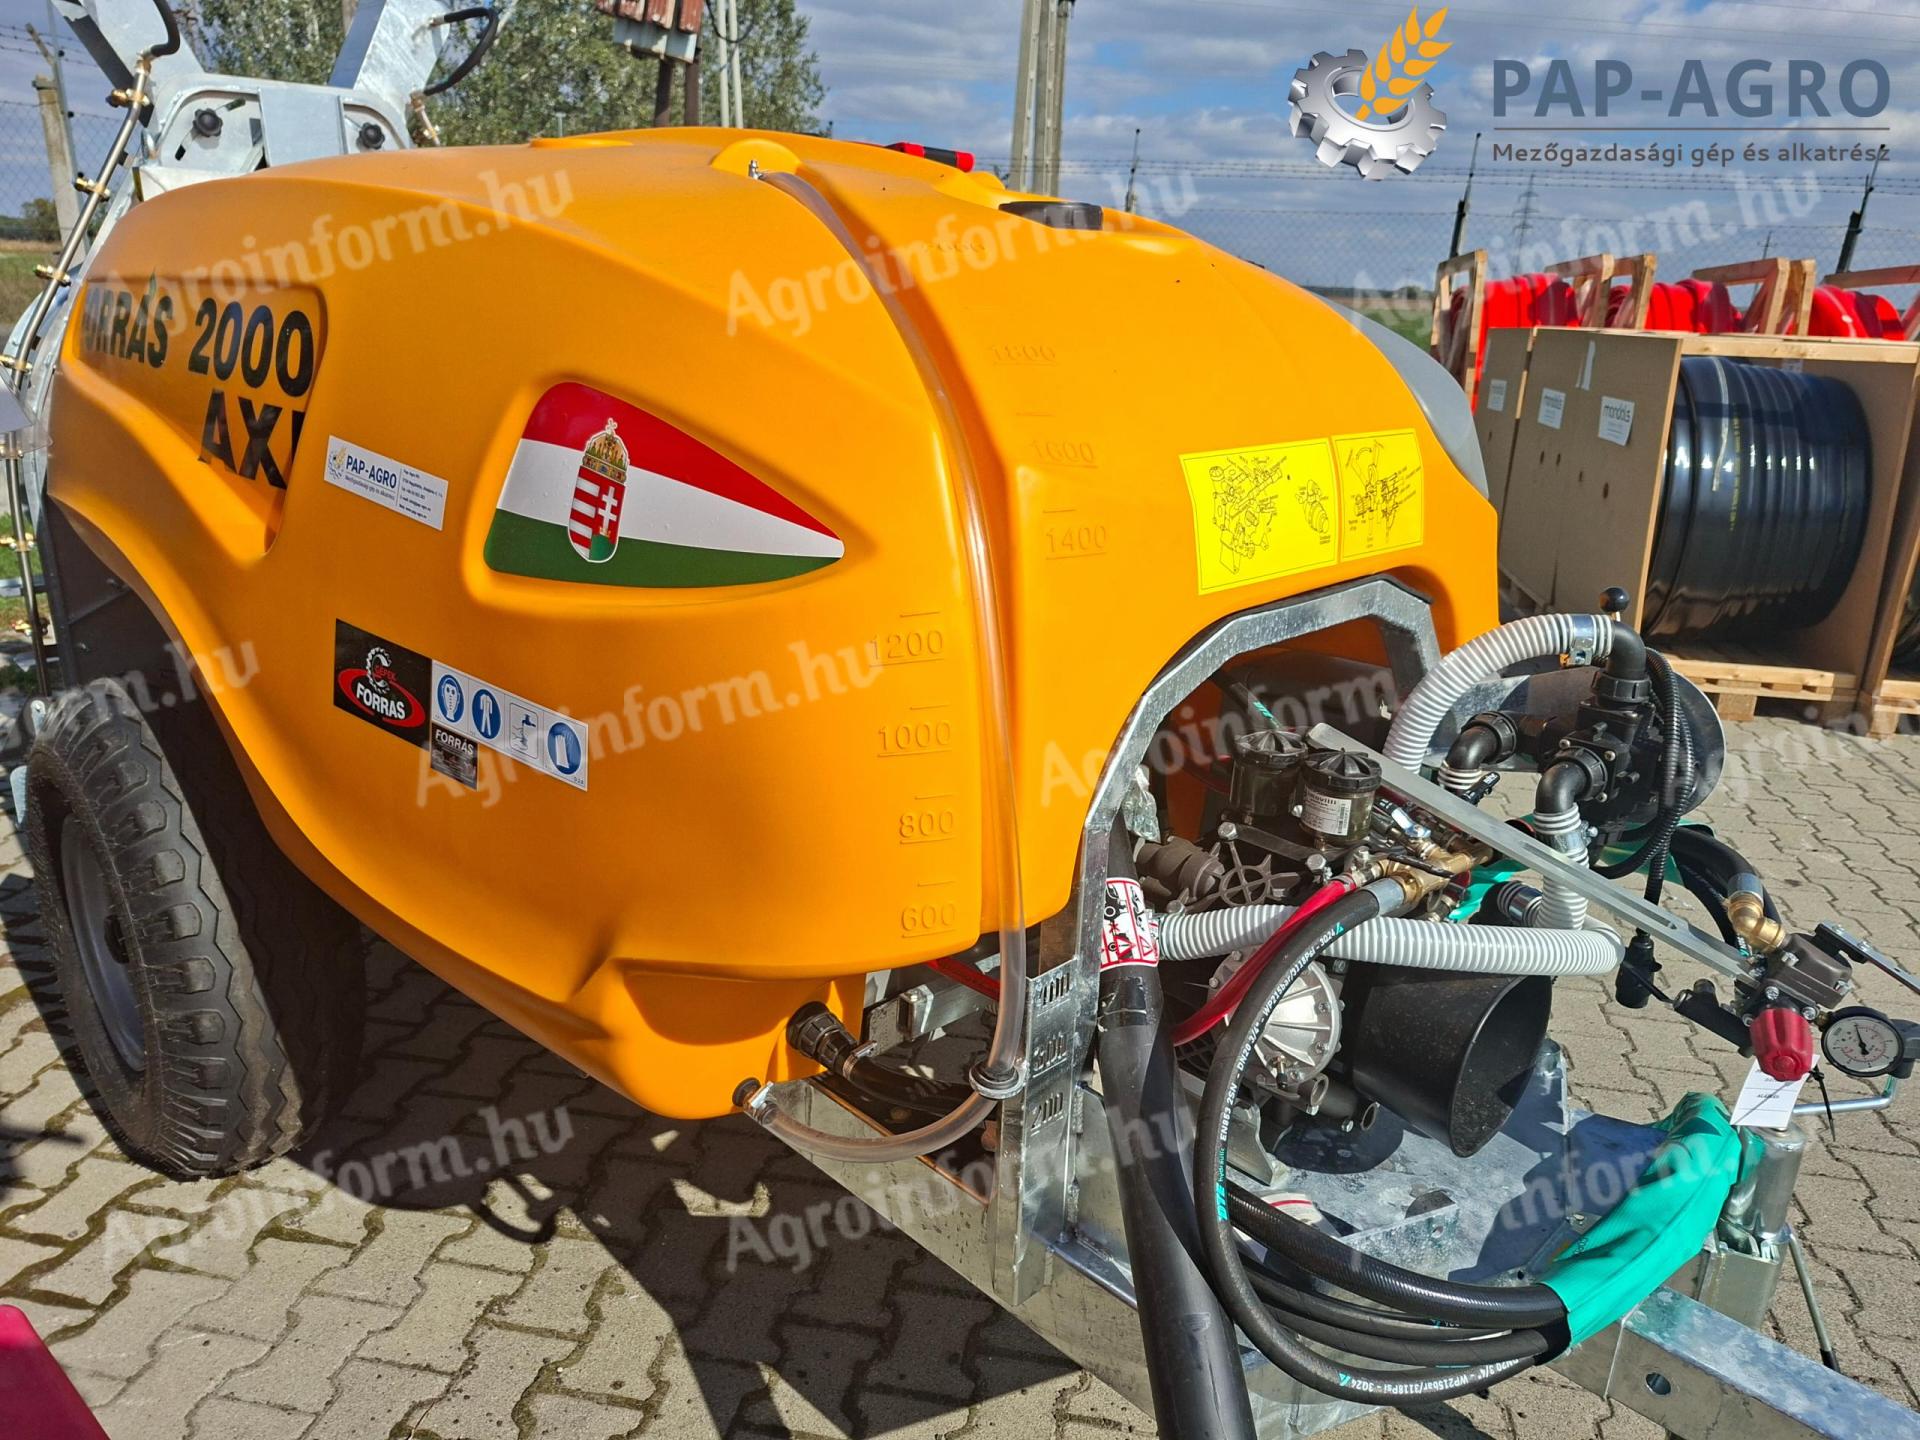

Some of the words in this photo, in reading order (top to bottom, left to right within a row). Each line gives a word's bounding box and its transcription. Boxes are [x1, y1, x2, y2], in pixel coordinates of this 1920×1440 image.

[187, 297, 315, 398] 2000
[345, 455, 397, 489] PAP-AGRO
[1045, 524, 1108, 554] 1400
[871, 629, 944, 661] 1200
[355, 682, 406, 721] FORRAS
[435, 728, 474, 755] FORRÁS
[878, 720, 952, 752] 1000
[899, 809, 955, 839] 800
[901, 901, 956, 932] 600
[1237, 1043, 1252, 1071] DN20
[1225, 1082, 1238, 1105] 2SN
[1219, 1107, 1233, 1141] EN853
[1384, 1373, 1469, 1395] WP215bar/3118Psi
